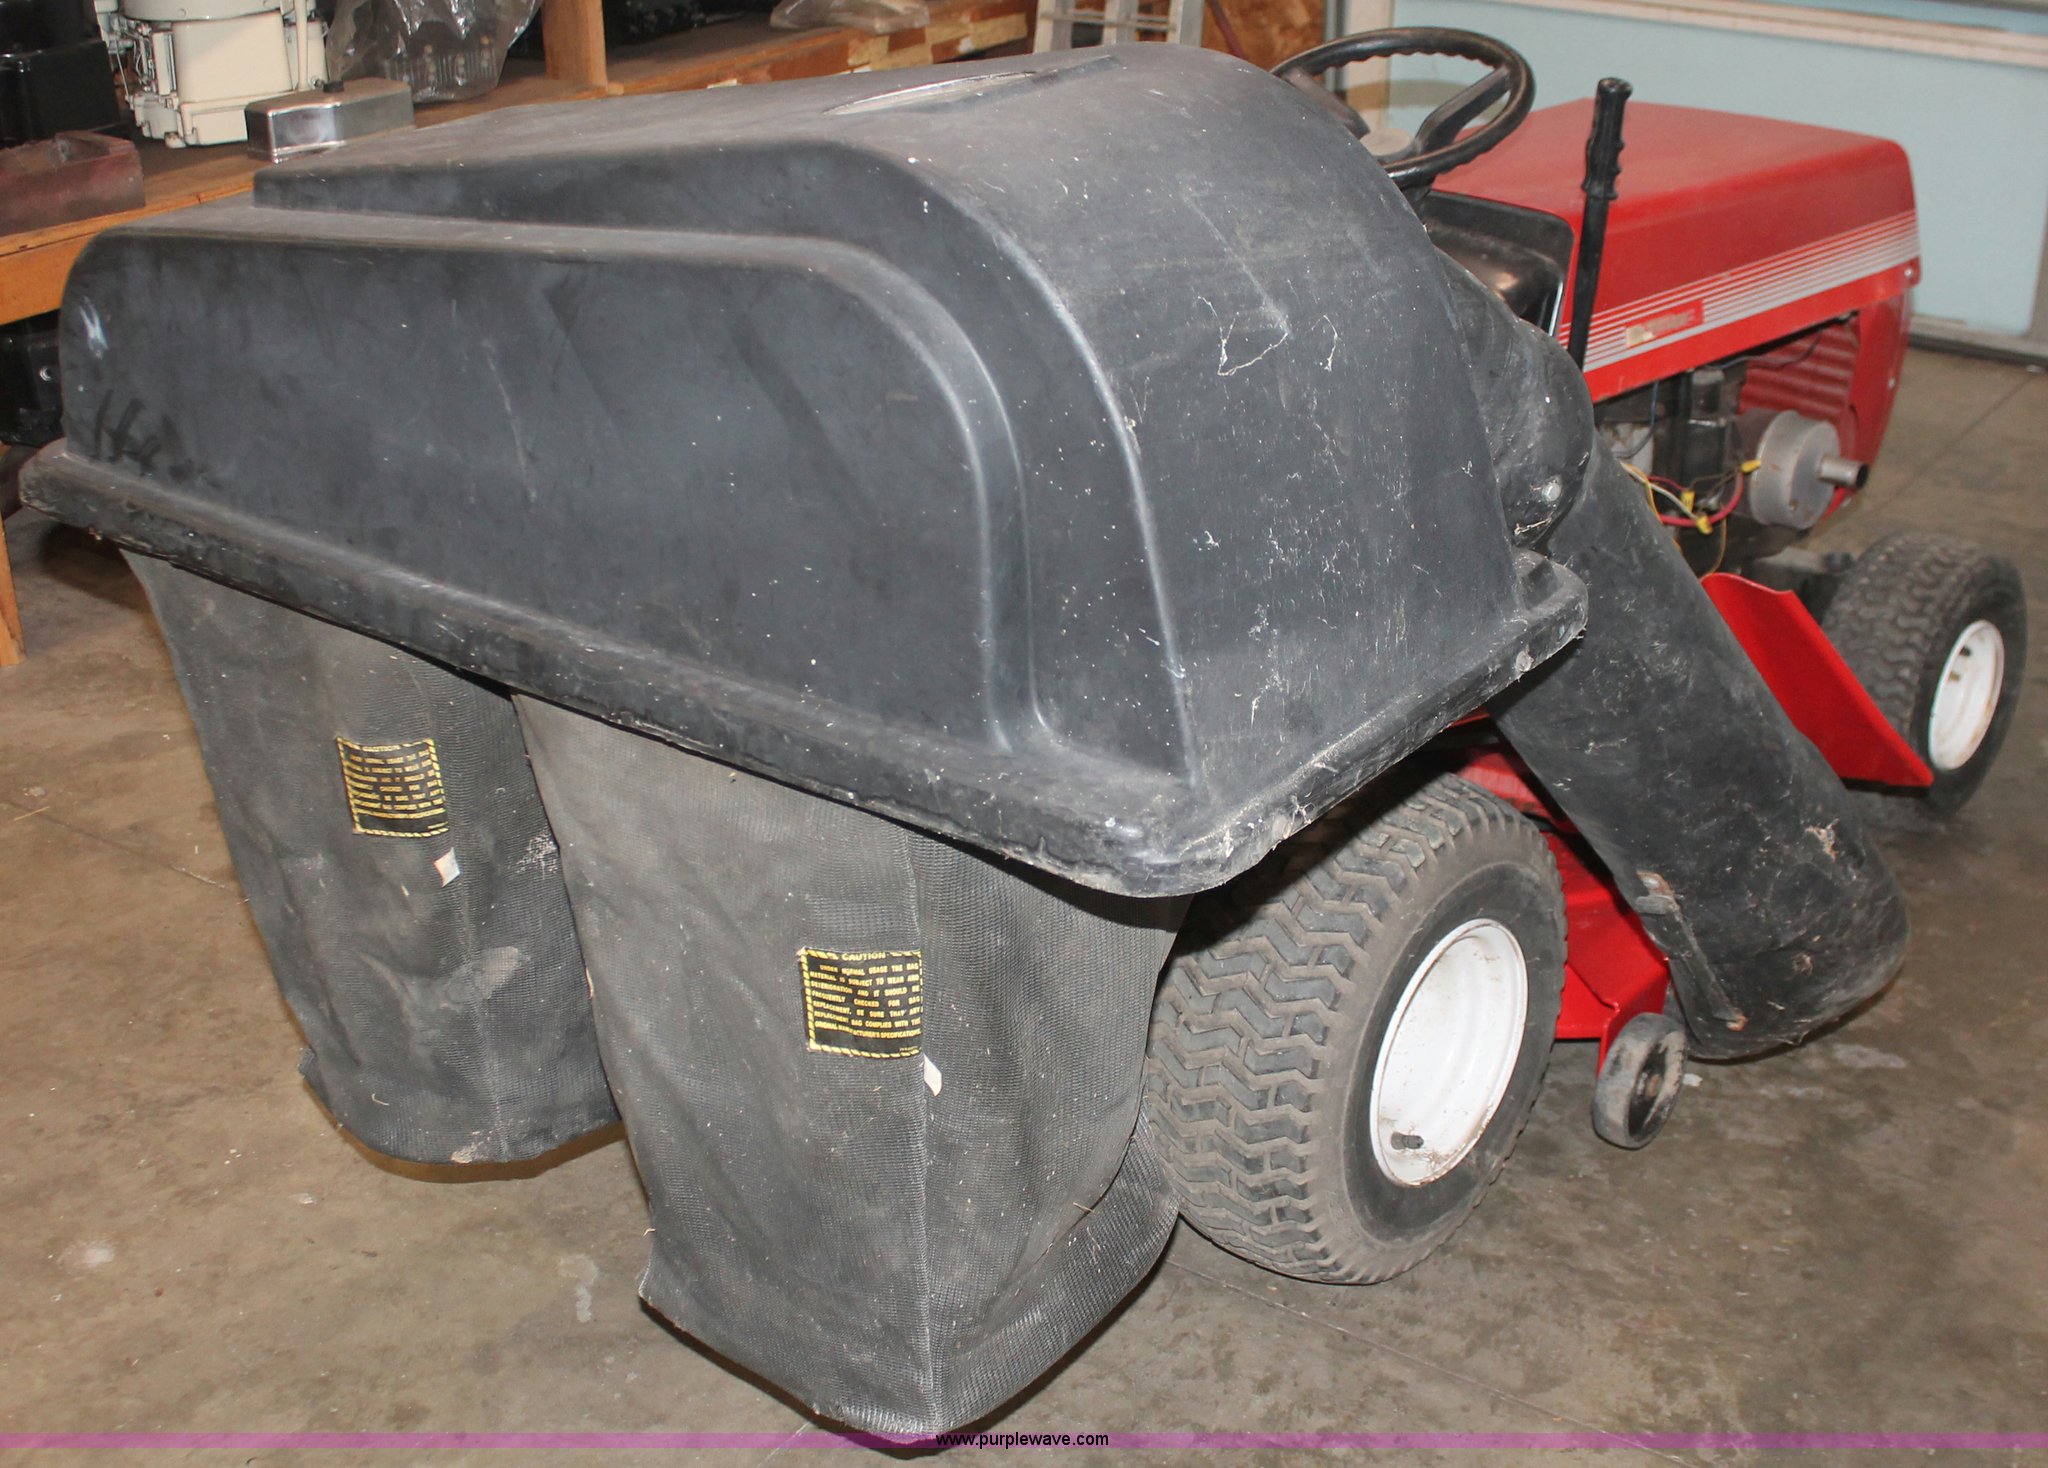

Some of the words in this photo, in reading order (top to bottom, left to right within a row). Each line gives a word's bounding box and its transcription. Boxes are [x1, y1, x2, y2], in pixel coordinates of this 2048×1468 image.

[842, 952, 886, 961] CAUTION
[892, 964, 903, 972] THE
[888, 976, 904, 984] WEAR
